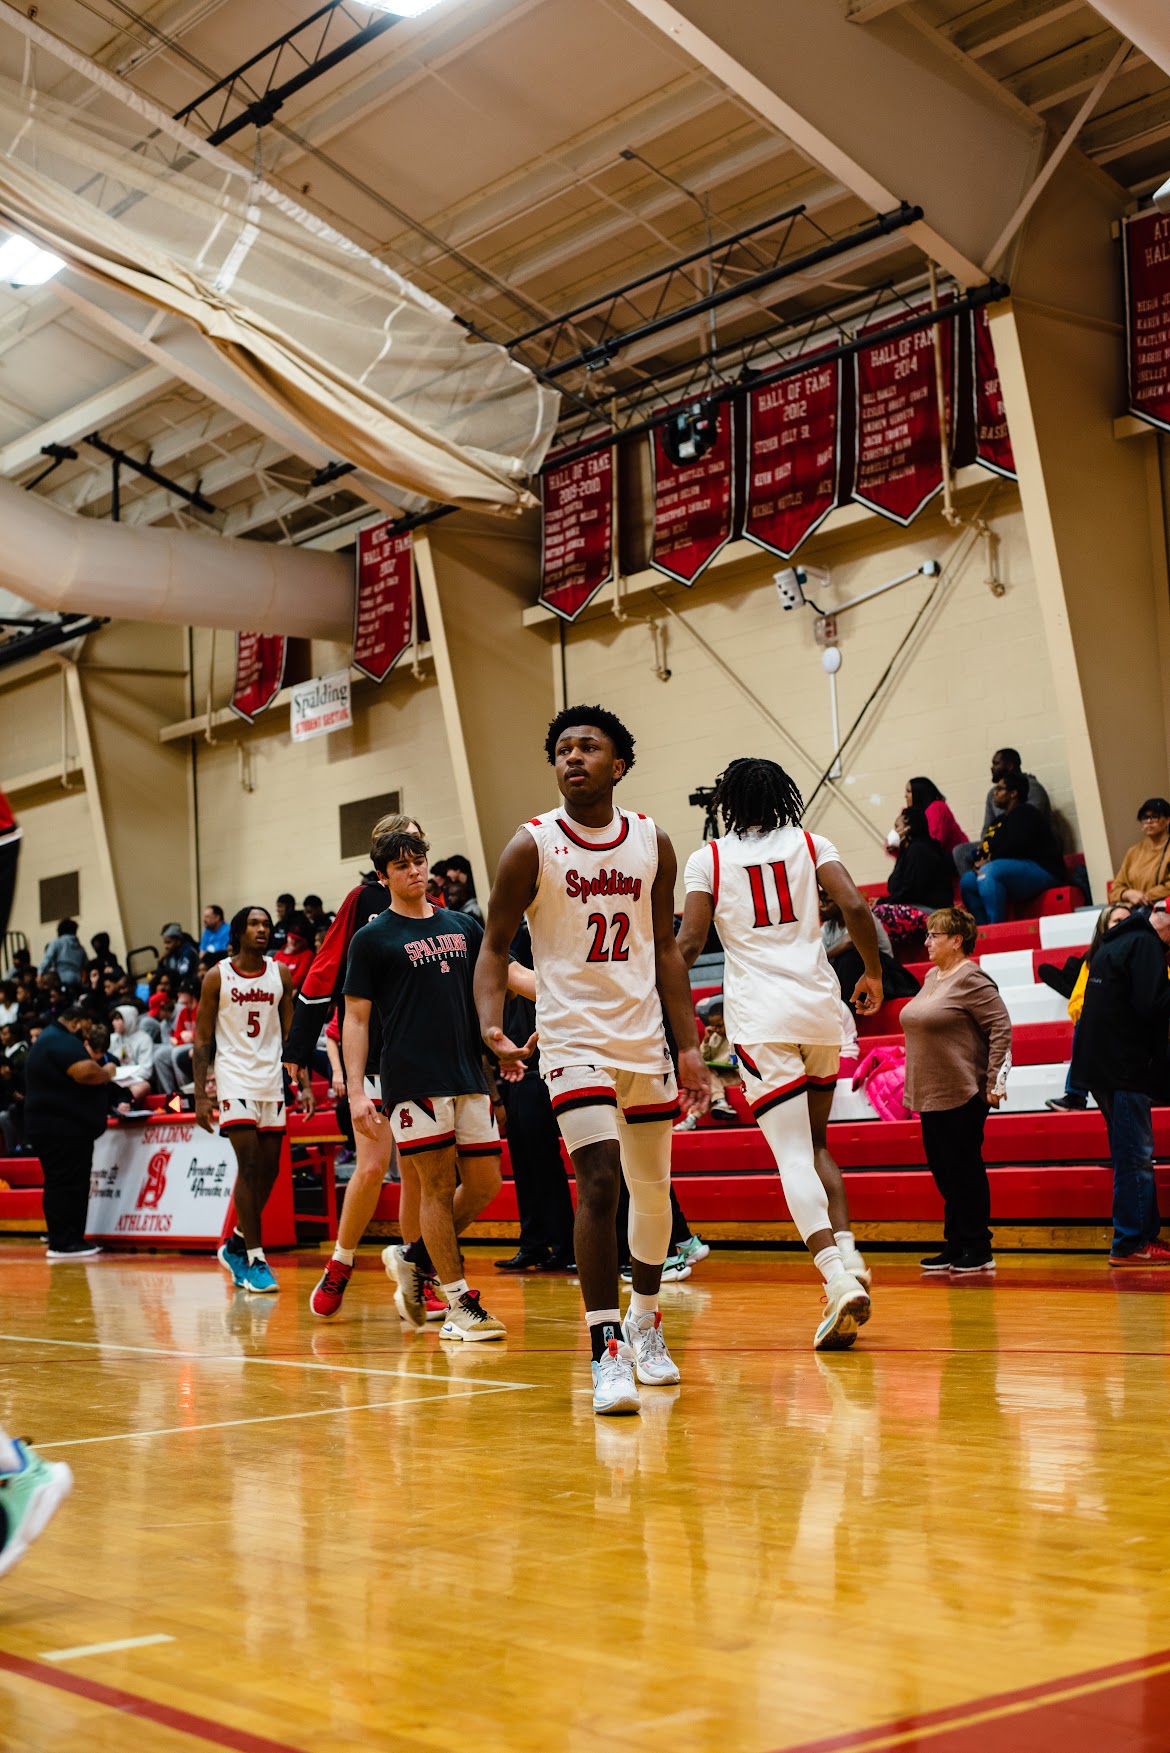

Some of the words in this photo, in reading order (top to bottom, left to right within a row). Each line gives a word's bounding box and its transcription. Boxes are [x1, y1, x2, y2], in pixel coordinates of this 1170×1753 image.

[870, 344, 898, 367] HALL
[899, 336, 913, 356] OF
[894, 354, 918, 379] 2014
[758, 388, 785, 413] HALL
[787, 382, 802, 401] OF
[805, 370, 832, 395] FAME
[783, 400, 808, 422] 2012
[548, 470, 571, 491] HALL
[572, 463, 583, 481] OF
[587, 453, 611, 476] FAME
[294, 683, 347, 719] Spalding
[295, 718, 321, 734] STUDENT
[323, 708, 348, 726] SECTION
[566, 868, 642, 904] Spalding
[743, 860, 799, 928] 11
[404, 933, 467, 961] SPALDING
[586, 911, 630, 962] 22
[231, 987, 275, 1006] Spalding
[247, 1011, 261, 1038] 5
[142, 1125, 194, 1144] SPALDING
[115, 1213, 173, 1232] ATHLETICS
